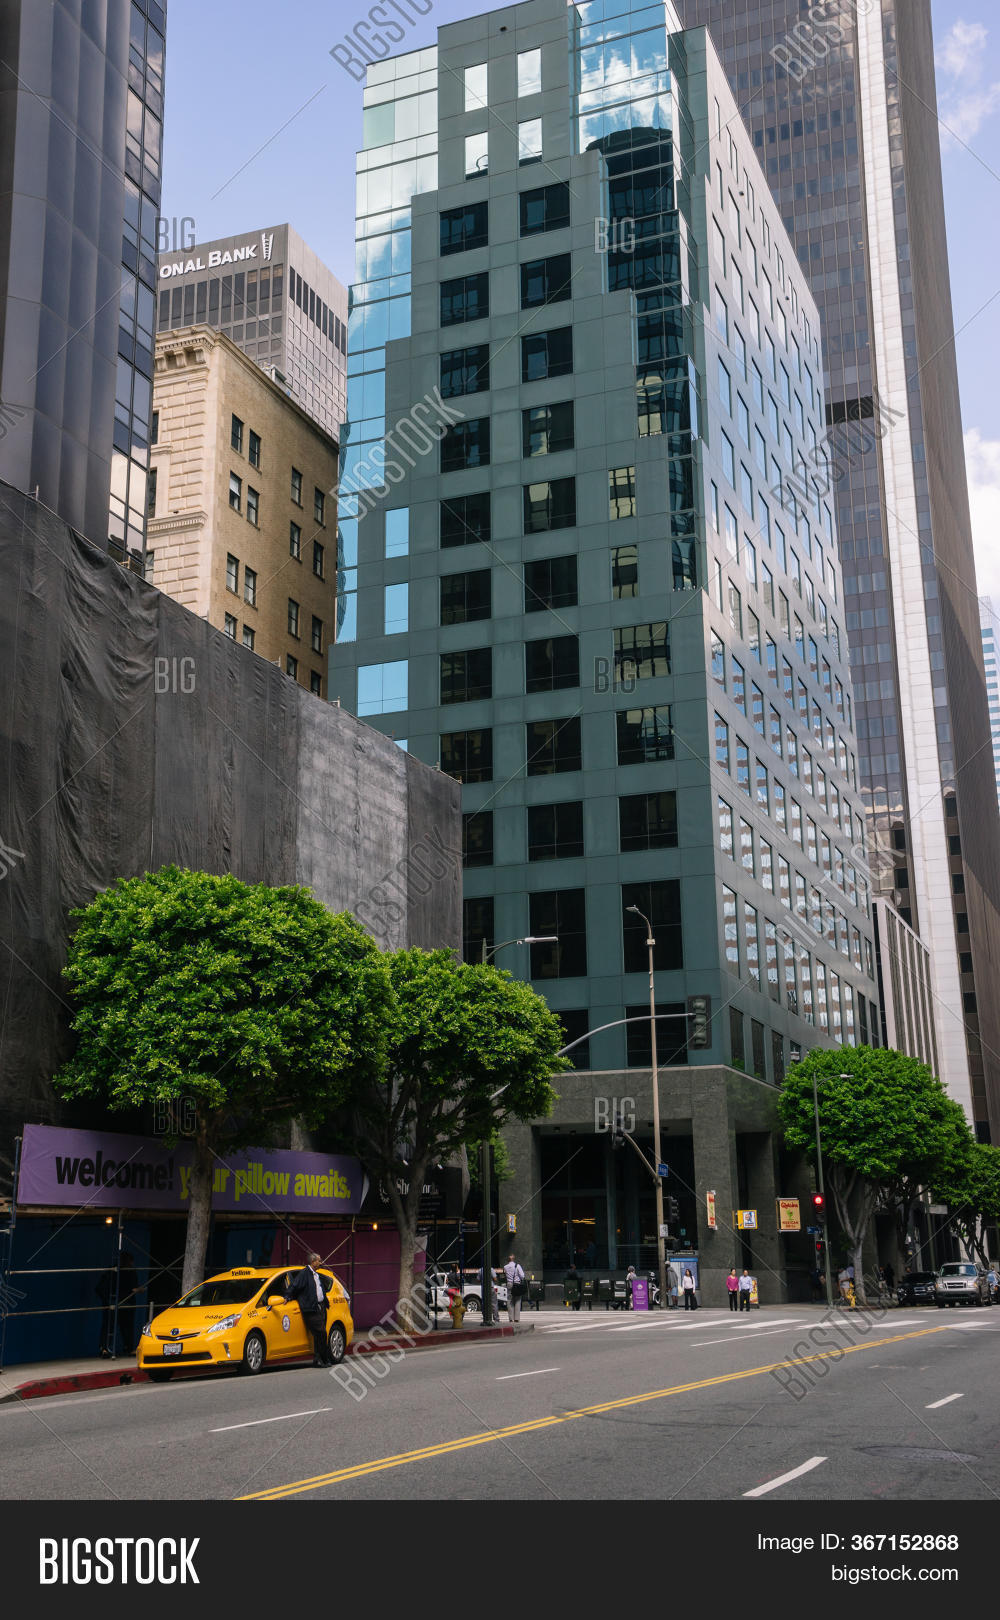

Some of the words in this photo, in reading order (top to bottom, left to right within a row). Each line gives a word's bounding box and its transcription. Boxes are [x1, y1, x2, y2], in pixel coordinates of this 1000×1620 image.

[159, 257, 205, 279] ONAL
[208, 244, 258, 268] BANK
[55, 1150, 175, 1191] welcome!
[179, 1166, 231, 1200] yur
[234, 1162, 291, 1202] pillow
[294, 1168, 351, 1199] awaits.
